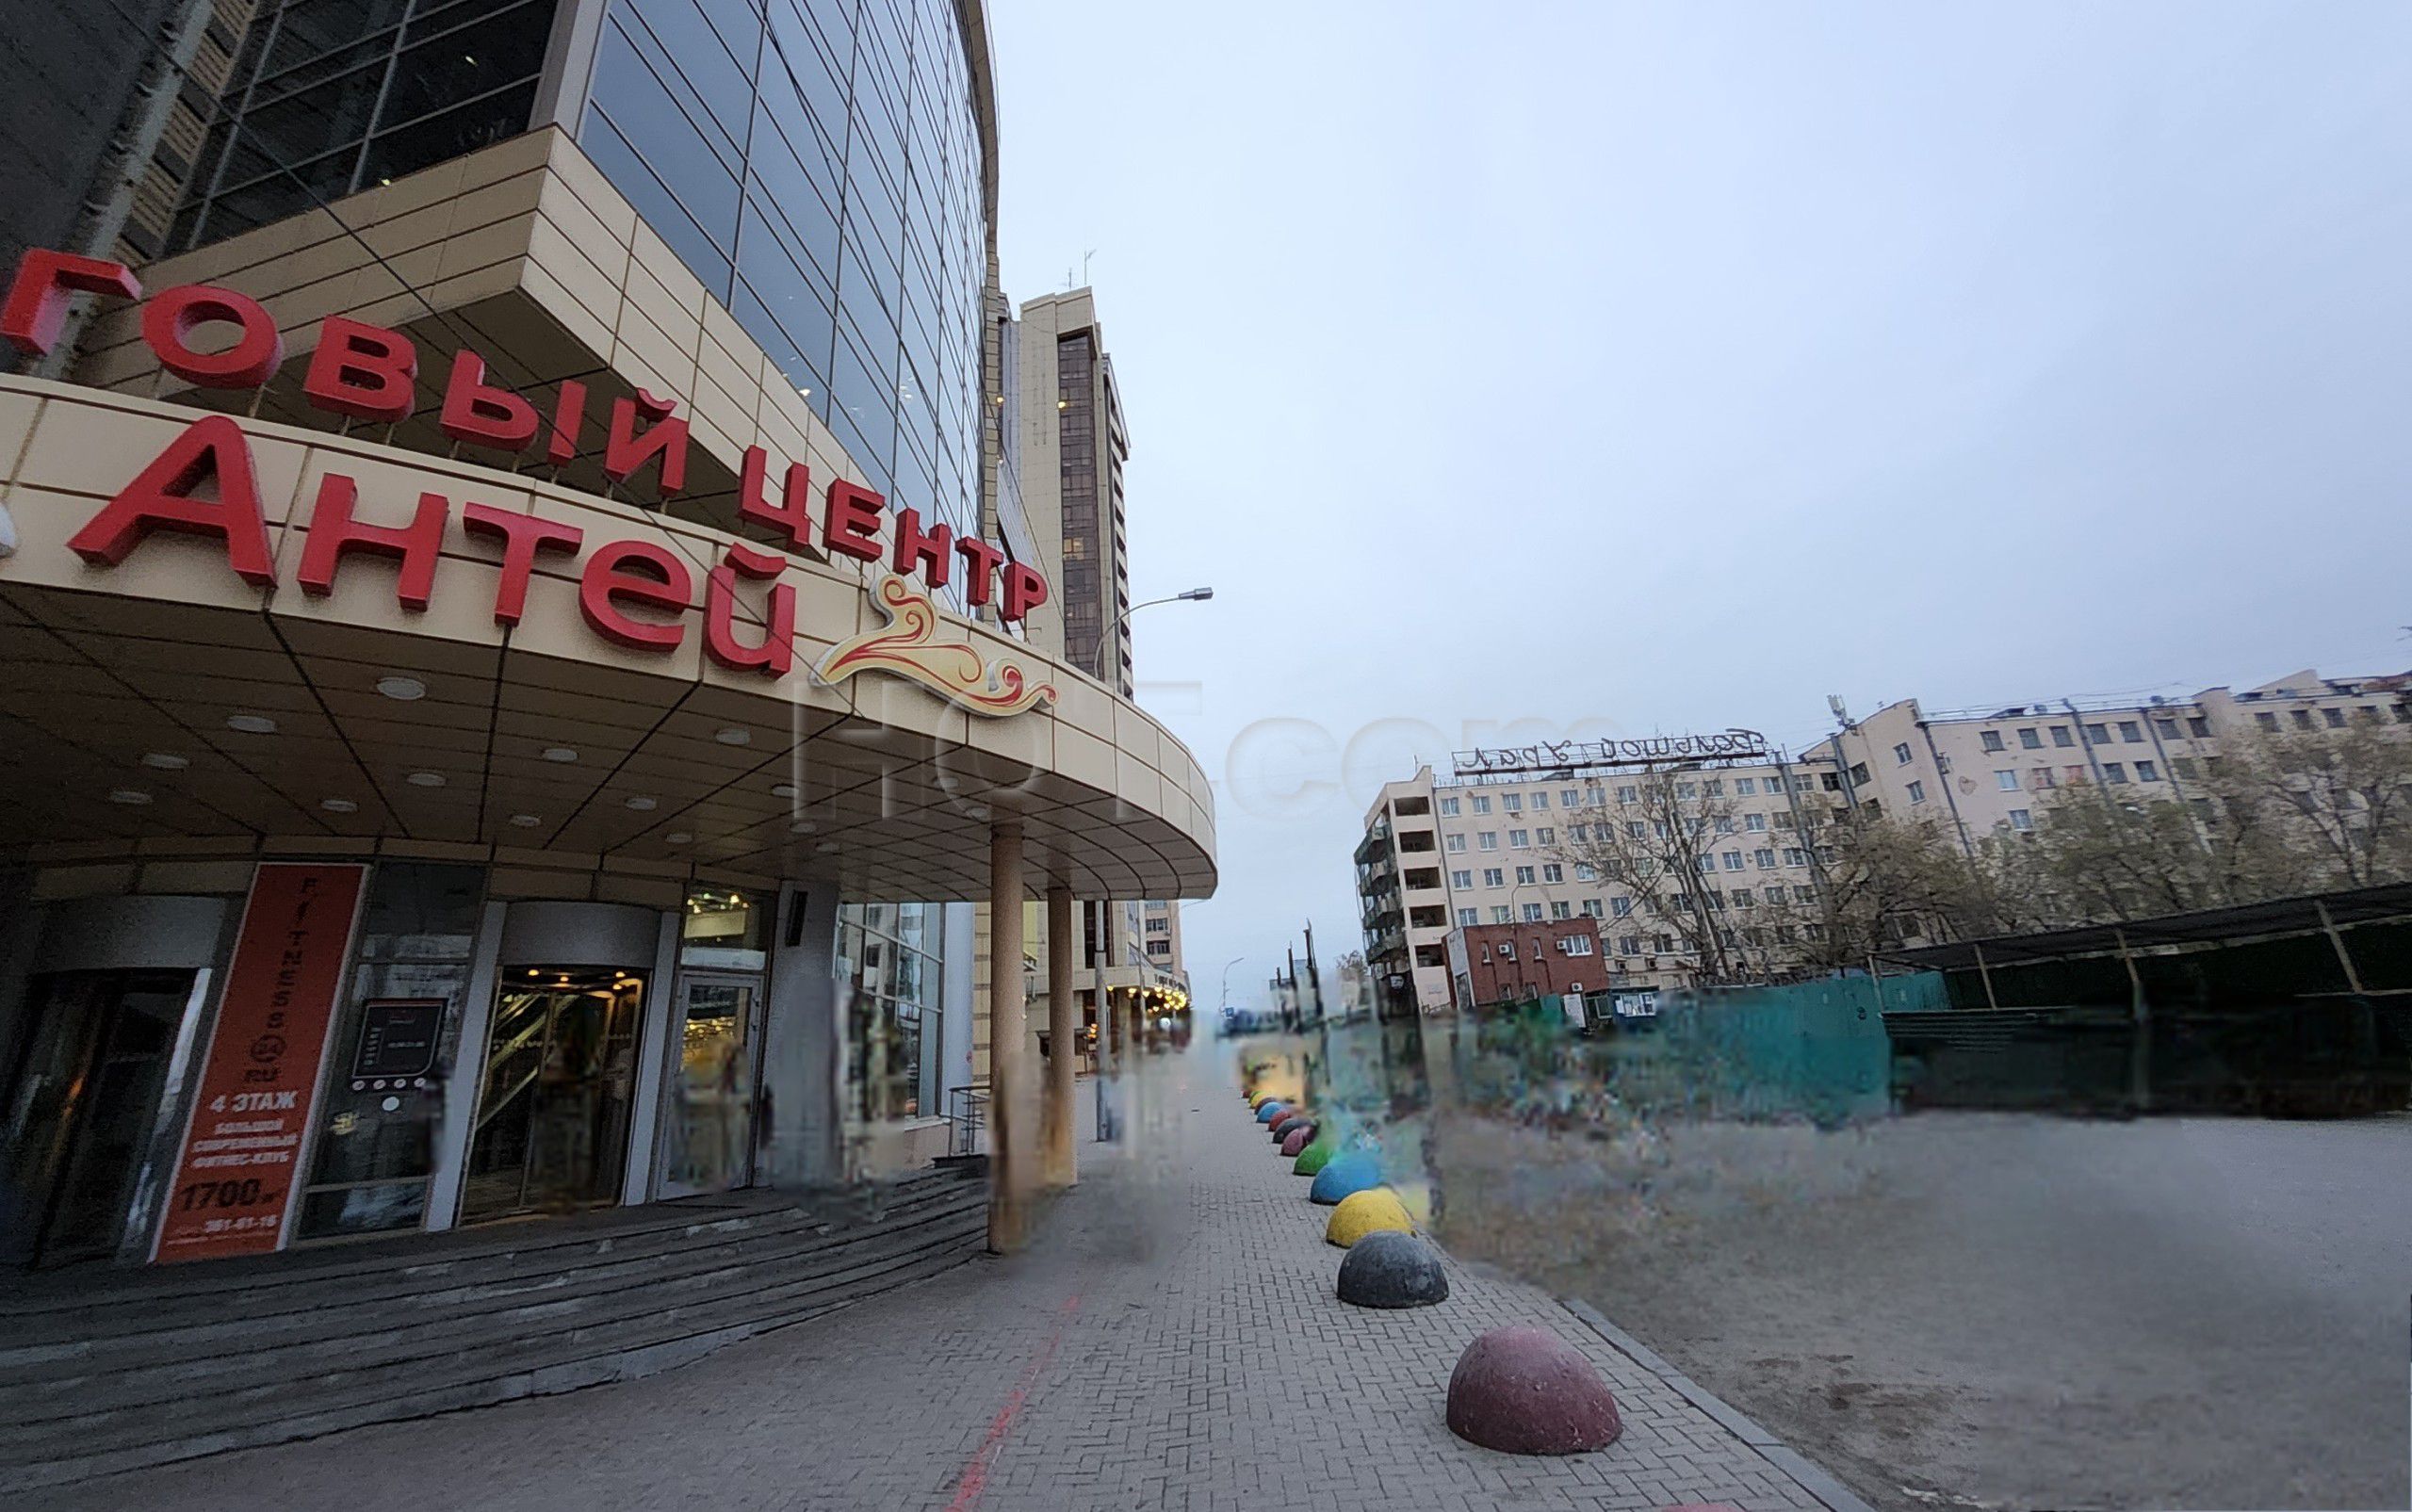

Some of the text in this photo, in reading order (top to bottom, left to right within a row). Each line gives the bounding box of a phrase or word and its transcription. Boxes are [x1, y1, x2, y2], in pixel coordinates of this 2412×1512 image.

[738, 445, 1048, 622] ЦЕНТР
[209, 1090, 299, 1113] 4 ЭТАЖ
[179, 1179, 260, 1211] 1700
